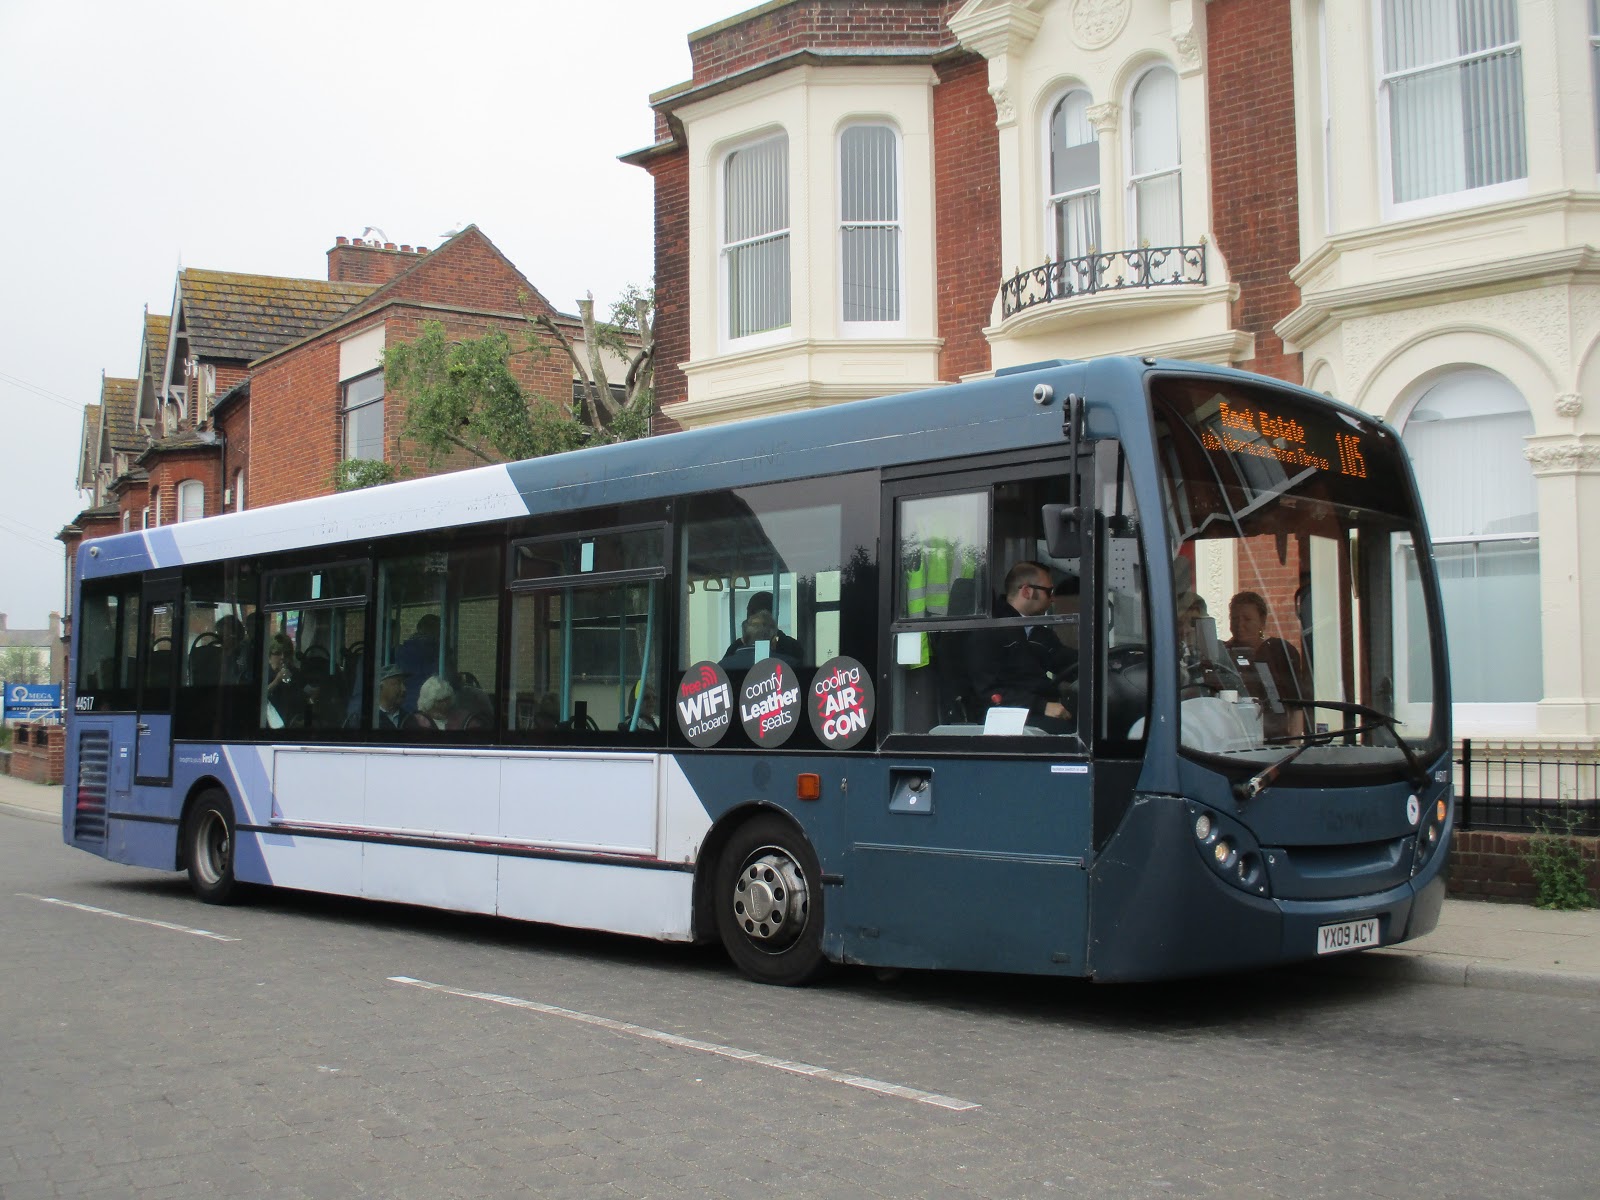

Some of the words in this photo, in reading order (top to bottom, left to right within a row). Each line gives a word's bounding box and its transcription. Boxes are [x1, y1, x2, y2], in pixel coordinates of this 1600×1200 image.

[1219, 402, 1257, 432] Rock
[1259, 411, 1306, 444] Estate
[1335, 432, 1367, 478] 105
[681, 678, 701, 697] free
[746, 672, 783, 699] comfy
[815, 666, 860, 695] cooling
[76, 697, 94, 711] 44517
[679, 683, 731, 725] WiFi
[741, 687, 799, 722] Leather
[825, 687, 858, 716] AIR
[688, 724, 701, 738] on
[702, 712, 728, 733] board
[761, 710, 792, 732] seats
[823, 708, 866, 741] CON
[1323, 926, 1350, 949] YX09
[1353, 922, 1374, 944] ACY
